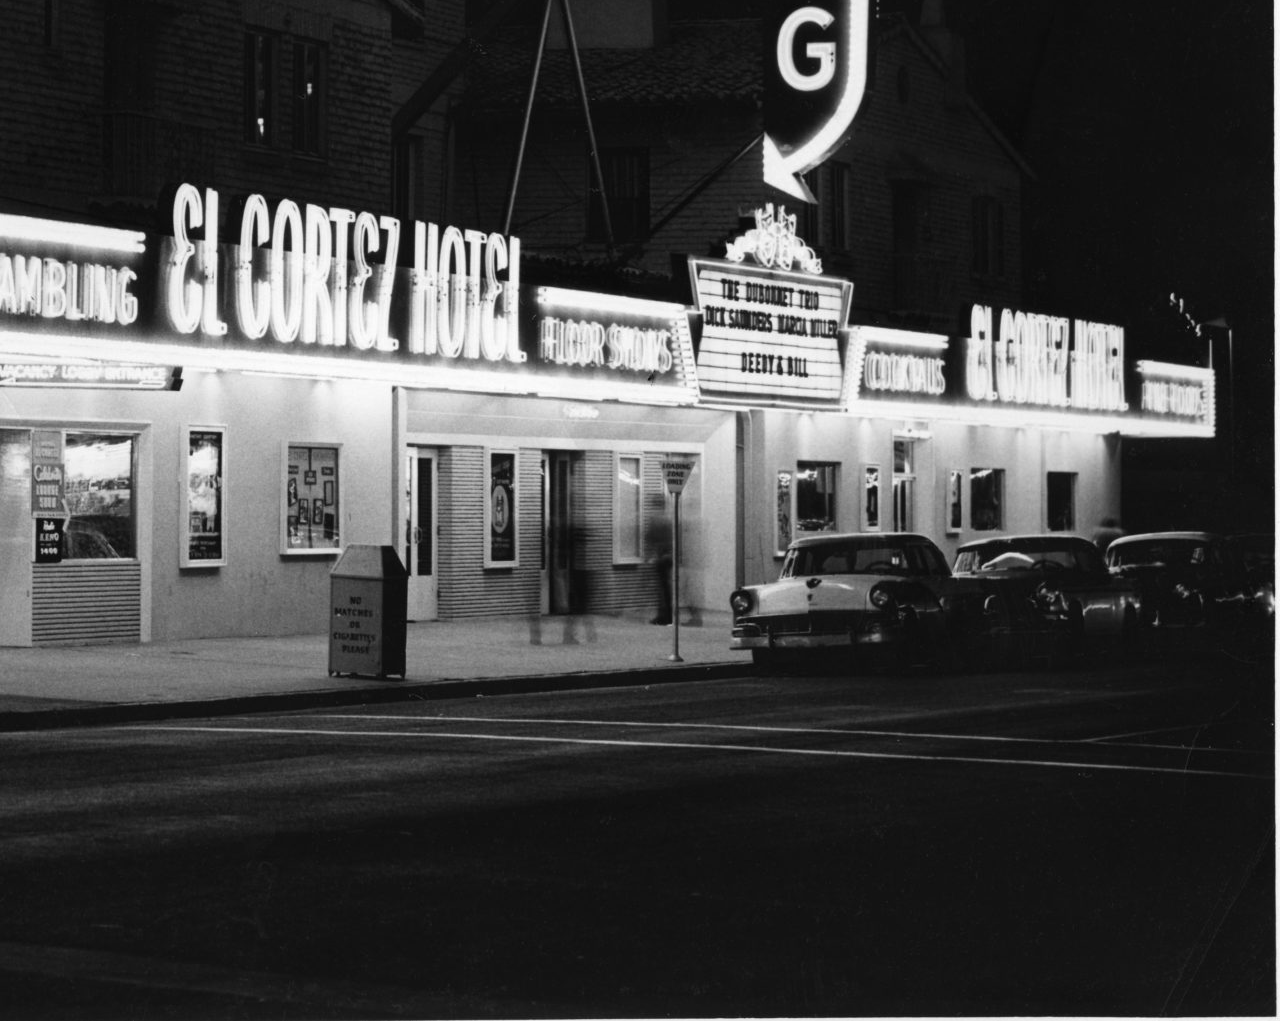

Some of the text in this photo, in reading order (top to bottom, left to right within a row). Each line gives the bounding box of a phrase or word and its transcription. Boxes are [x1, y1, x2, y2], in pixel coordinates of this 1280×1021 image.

[167, 182, 527, 363] EL CORTEZ HOTEL
[721, 278, 819, 311] THE DUBONNET TRIO
[704, 305, 838, 339] DICK SAUNDERS MARCIA MILLER
[540, 315, 673, 374] FLOOR SHOWS
[741, 352, 809, 378] DEEDY & BILL
[334, 607, 373, 617] MATCHES
[349, 596, 362, 605] NO
